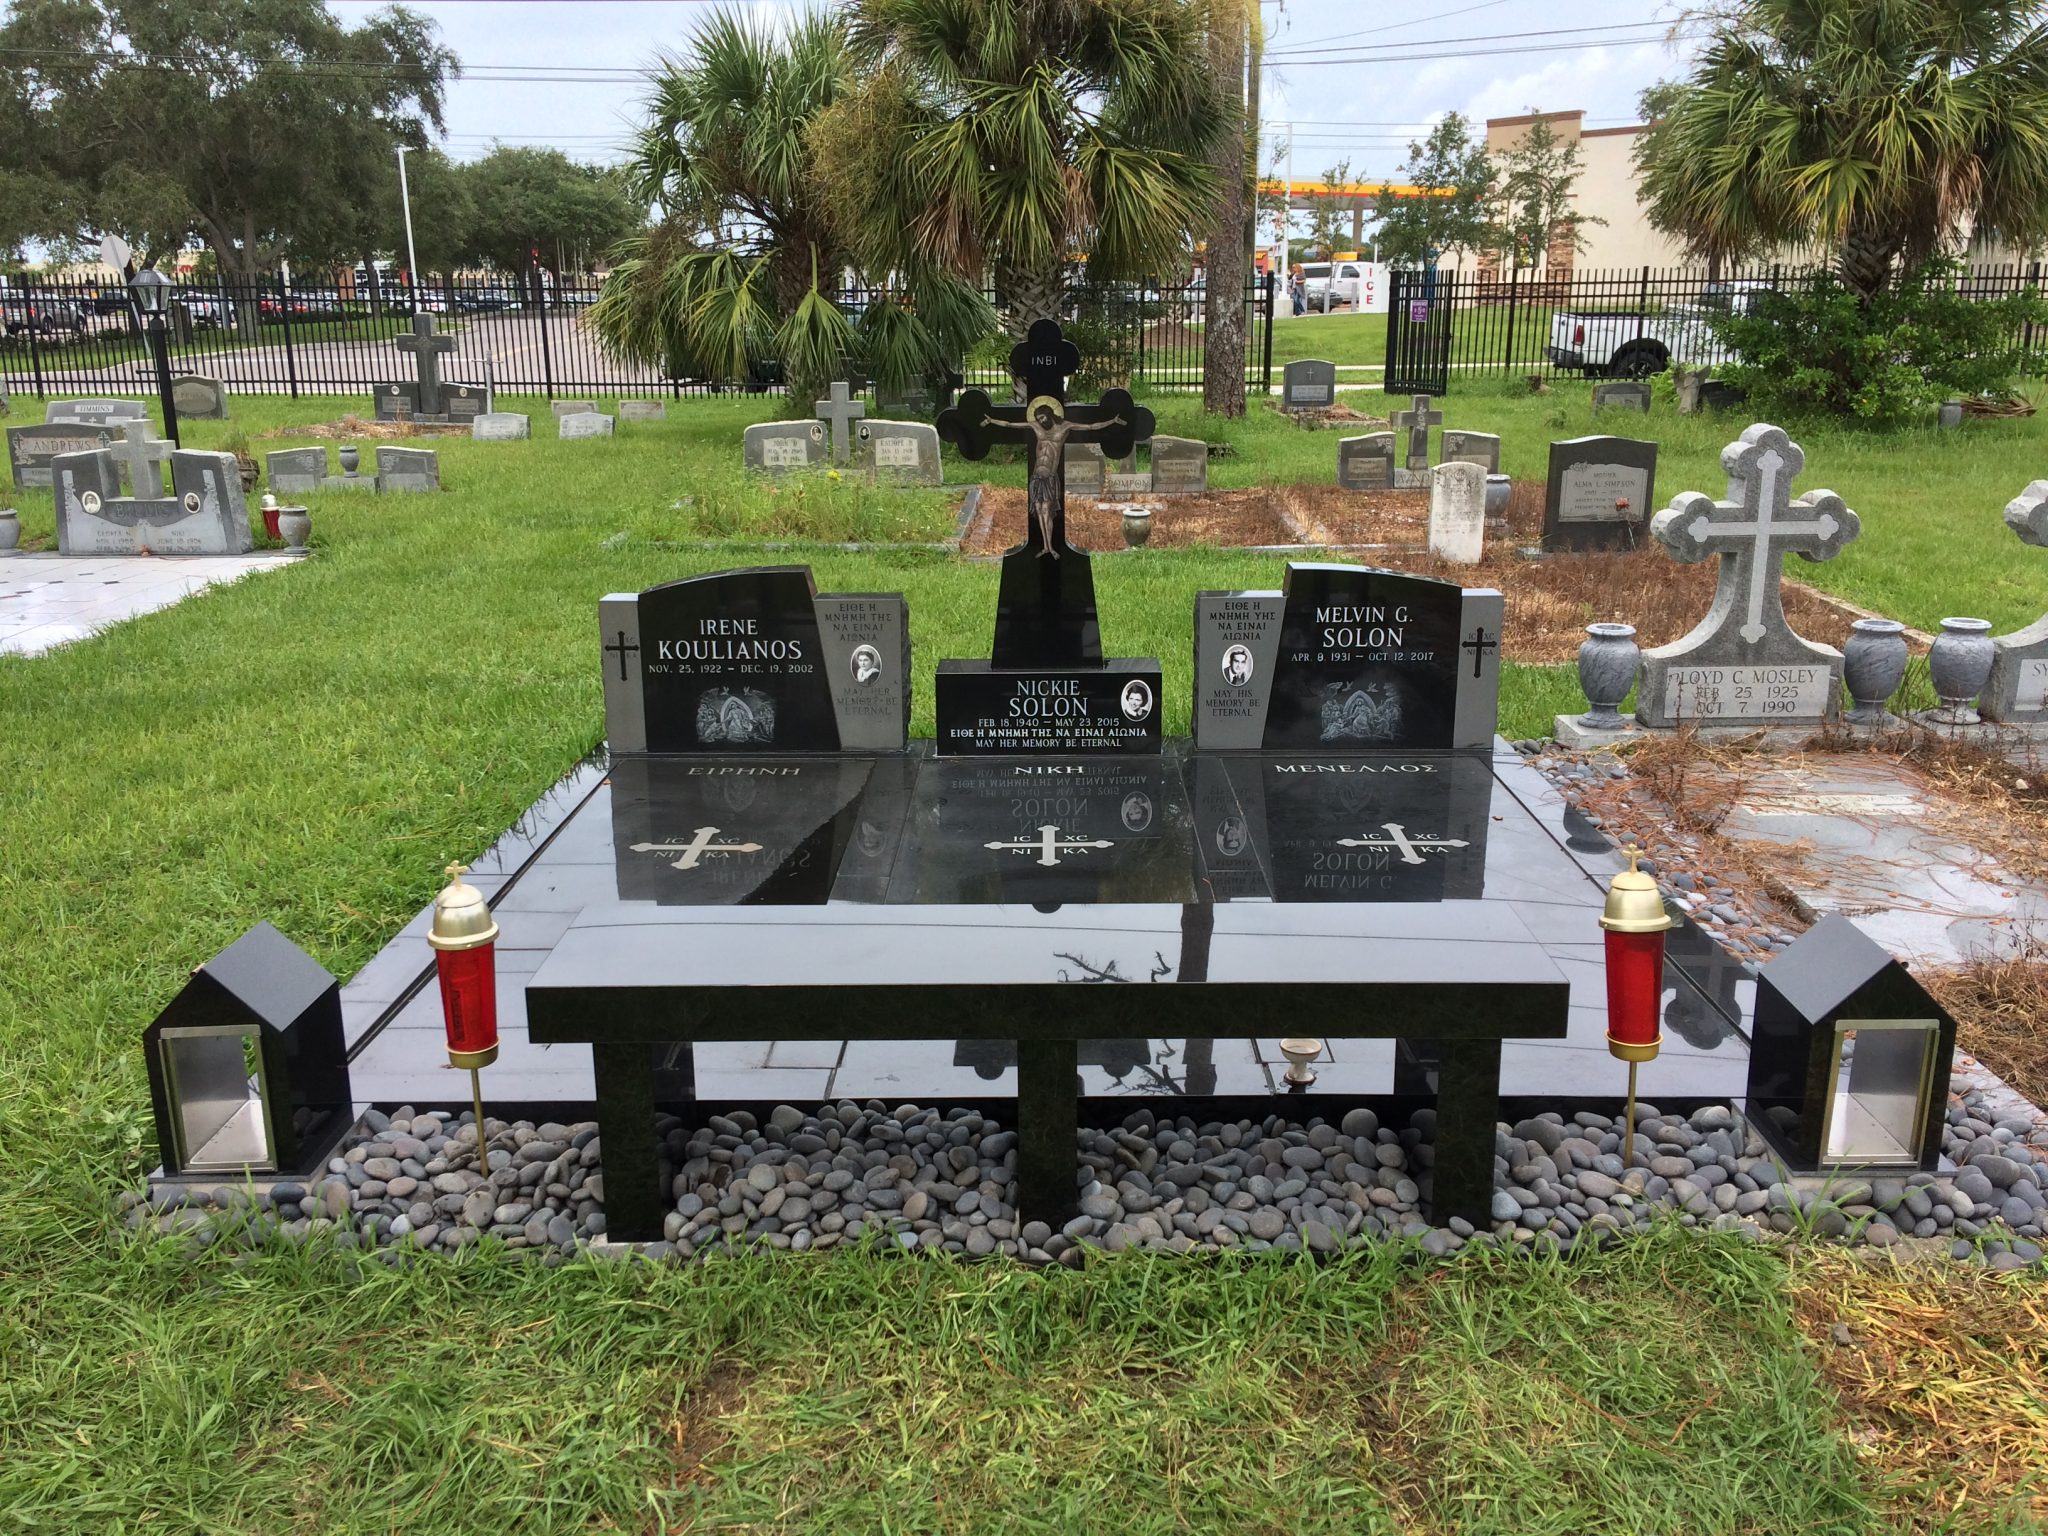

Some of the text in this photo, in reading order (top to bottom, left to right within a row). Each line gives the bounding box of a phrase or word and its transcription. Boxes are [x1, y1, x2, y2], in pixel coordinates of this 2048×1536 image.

[1366, 267, 1374, 304] ICE
[33, 440, 92, 452] ANDREWS
[1603, 479, 1636, 488] SIMPSON
[1224, 601, 1249, 611] ΕΙΘΕ
[1209, 612, 1250, 621] ΜΝΗΜΗ
[1315, 606, 1413, 624] MELVIN G.
[699, 619, 758, 636] IRENE
[1237, 622, 1267, 631] ΕΙΝΑΙ
[1322, 627, 1404, 648] SOLON
[658, 639, 802, 660] KOULIANOS
[1331, 652, 1351, 661] 1931
[1410, 651, 1435, 661] 2017
[649, 664, 673, 674] NOV.
[700, 664, 722, 673] 1922
[740, 664, 764, 673] DEC.
[788, 664, 814, 673] 2002
[1752, 669, 1819, 684] MOSLEY
[1016, 680, 1081, 696] NICKIE
[1767, 686, 1799, 698] 1925
[1213, 689, 1253, 698] MAY HIS
[1009, 697, 1088, 718] SOLON
[1205, 699, 1261, 707] MEMORY BE
[1762, 700, 1796, 713] 1990
[1212, 708, 1253, 717] ETERNAL
[1016, 718, 1039, 727] 1940
[1055, 718, 1075, 727] MAY
[1097, 717, 1120, 727] 2015
[950, 728, 975, 738] ΕΙΘΕ
[988, 728, 1029, 738] ΜΝΗΜΗ
[1031, 728, 1052, 738] ΤΗΣ
[1055, 728, 1071, 737] ΝΑ
[1074, 728, 1104, 737] ΕΙΝΑΙ
[1108, 728, 1148, 737] ΑΙΩΝΙΑ
[975, 739, 1122, 748] MAY HER MEMORY BE ETERNAL
